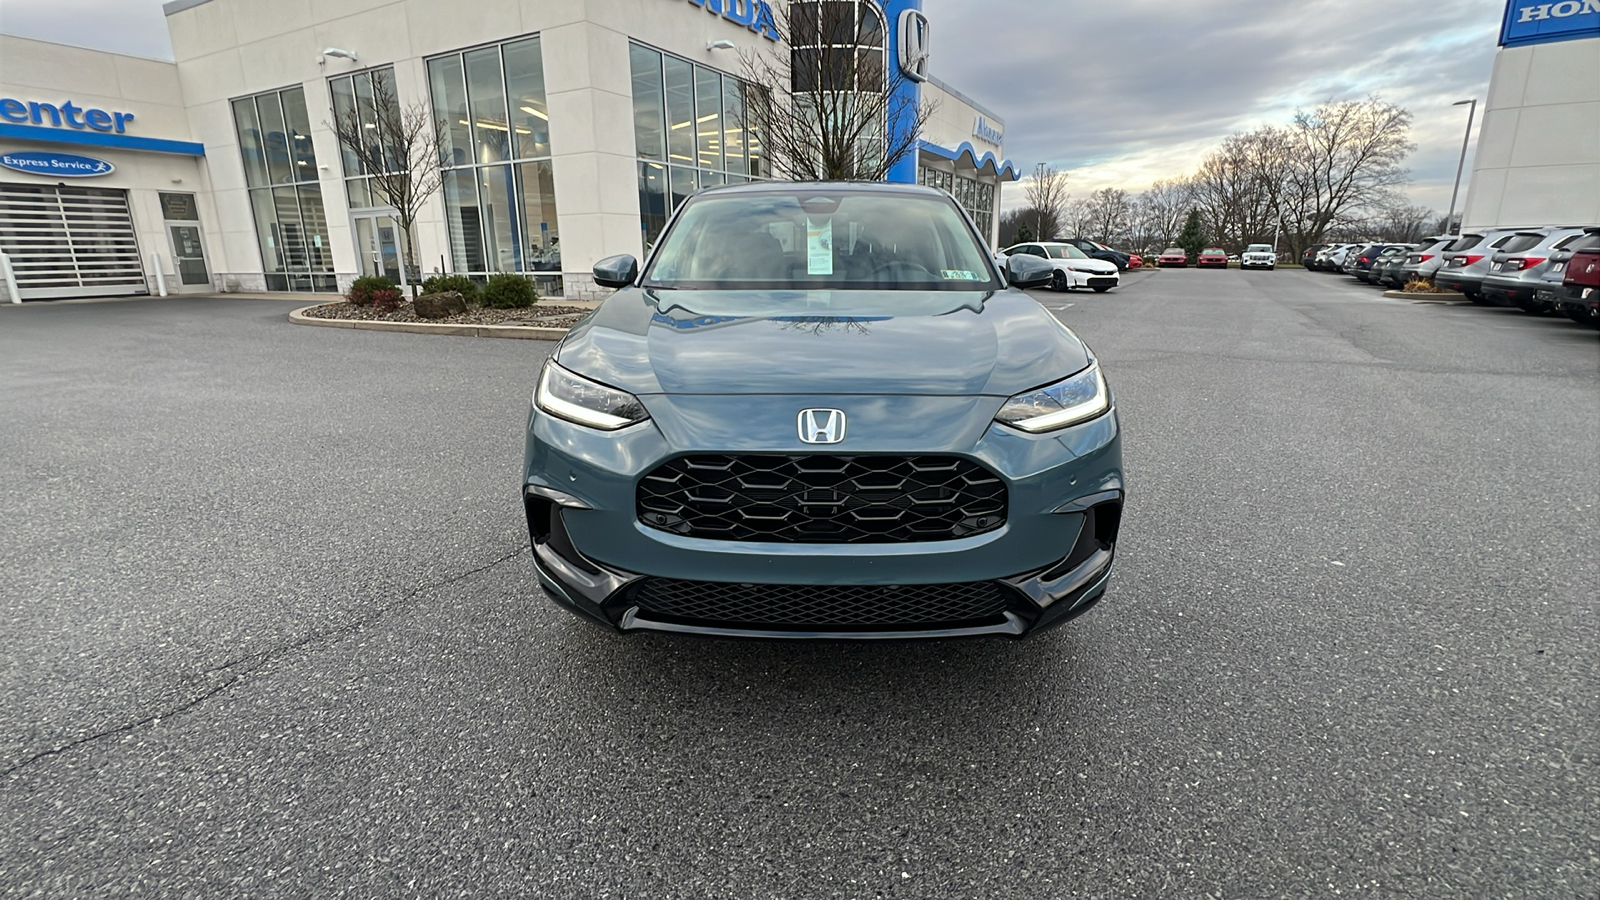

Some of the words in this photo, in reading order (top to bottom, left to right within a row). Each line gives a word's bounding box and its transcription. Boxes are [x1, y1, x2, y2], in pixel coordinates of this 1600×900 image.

[0, 98, 134, 133] enter
[3, 156, 49, 167] Express
[51, 159, 92, 170] Service
